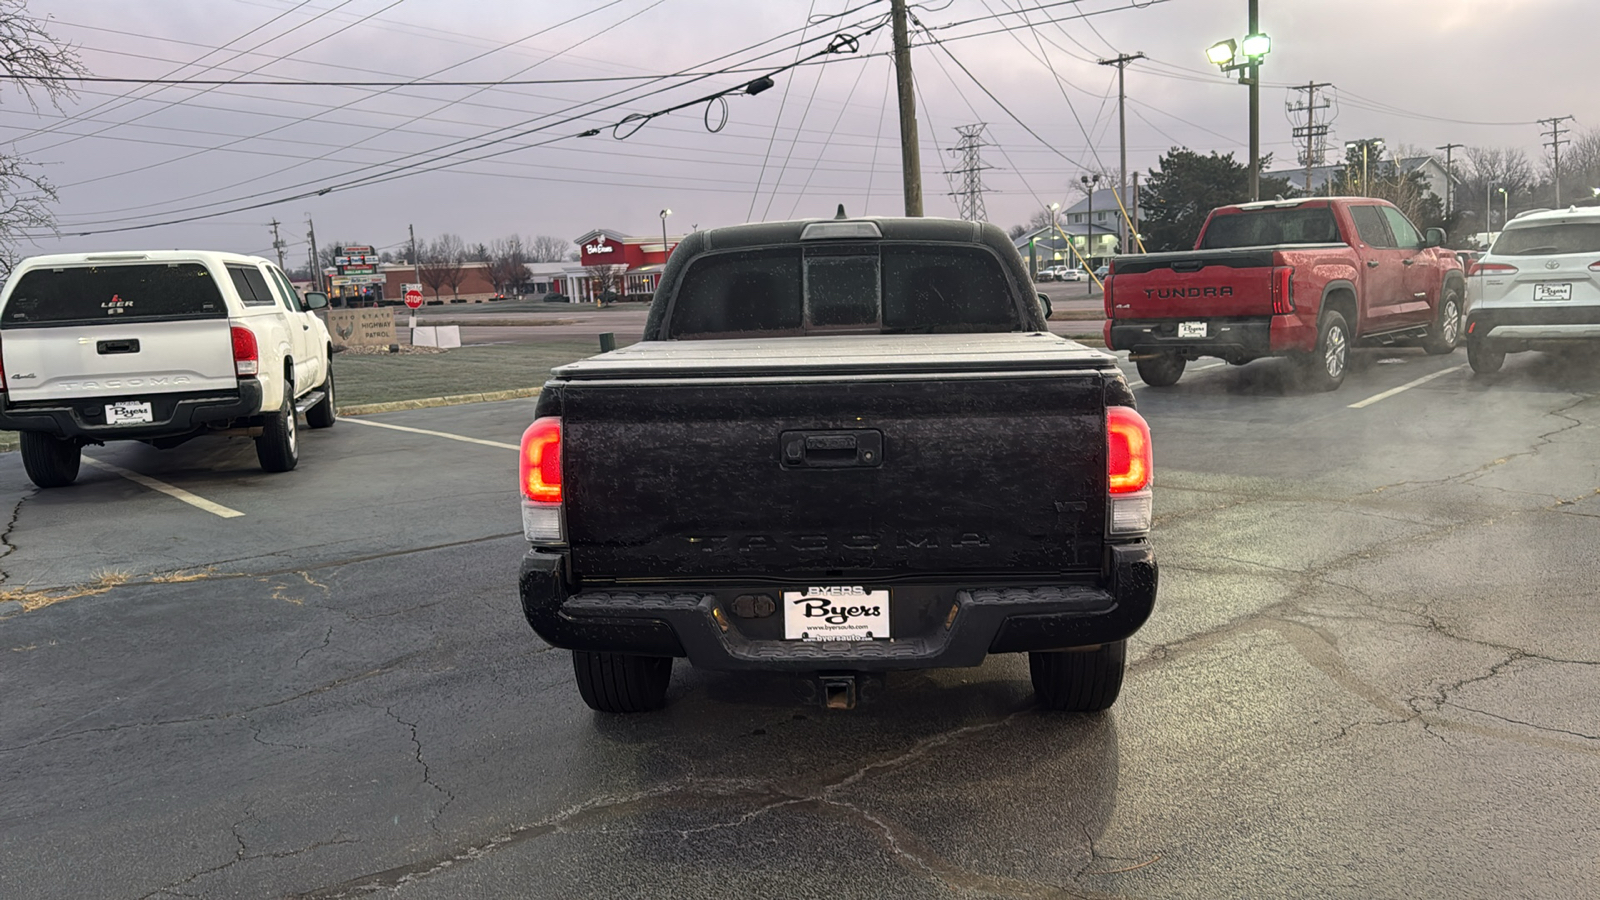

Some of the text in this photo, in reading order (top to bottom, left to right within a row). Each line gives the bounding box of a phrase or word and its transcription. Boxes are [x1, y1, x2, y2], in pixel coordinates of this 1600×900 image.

[1144, 286, 1233, 299] TUNDRA
[405, 295, 422, 304] STOP
[361, 321, 391, 329] HIGHWAY
[58, 376, 191, 391] TACOMA
[808, 586, 863, 596] BYERS
[793, 598, 880, 624] Byers
